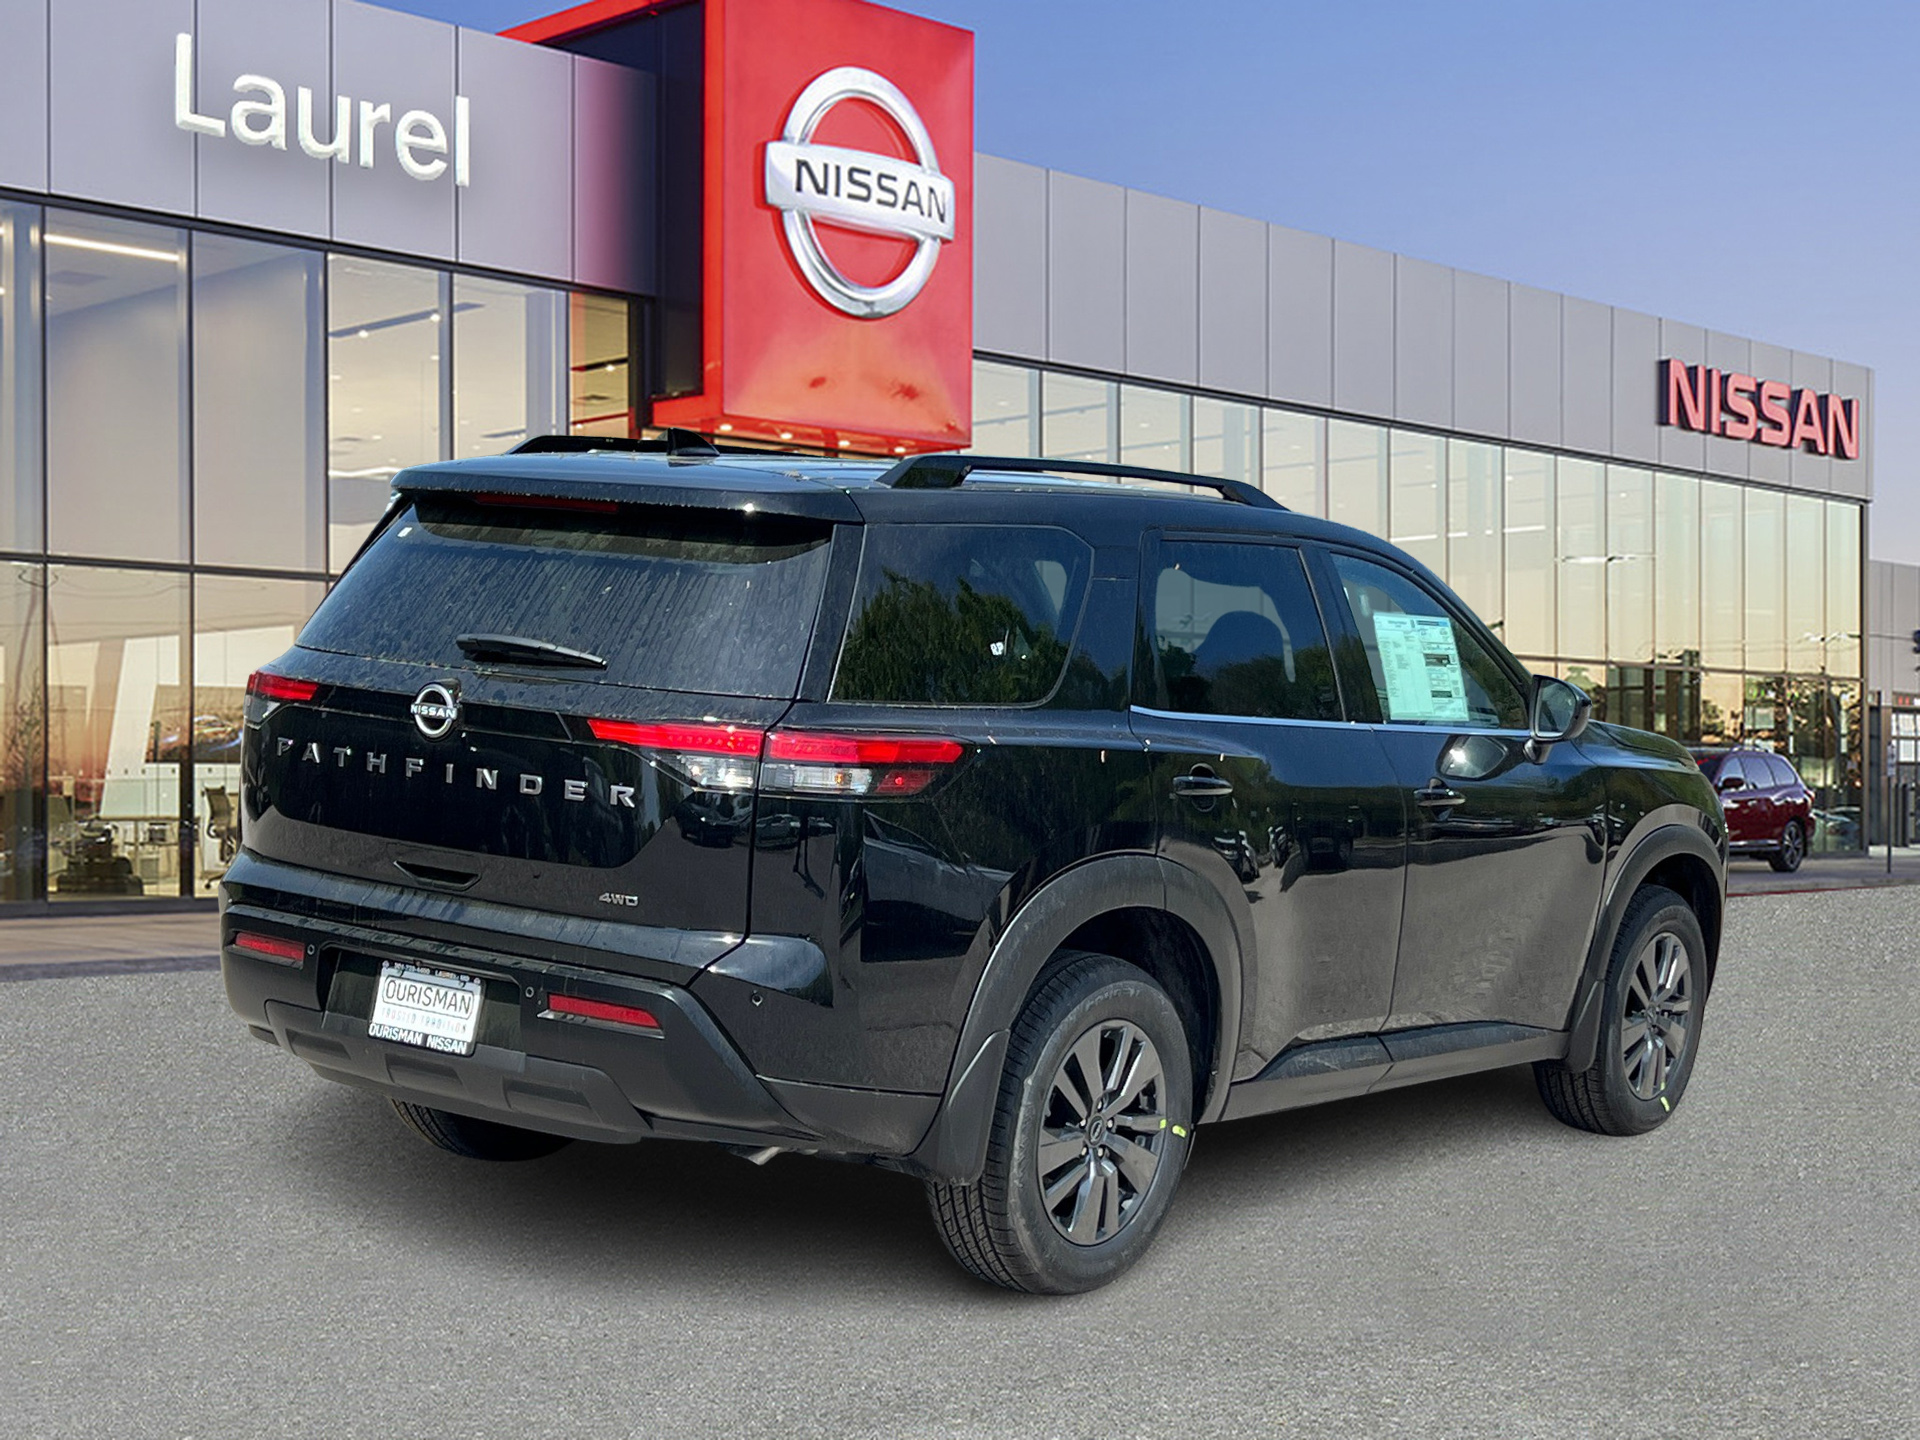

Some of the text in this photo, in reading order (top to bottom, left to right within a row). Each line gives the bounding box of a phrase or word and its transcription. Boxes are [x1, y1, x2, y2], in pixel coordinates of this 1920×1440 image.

[175, 33, 469, 187] Laurel
[795, 158, 947, 223] NISSAN
[1658, 358, 1860, 460] NISSAN
[411, 704, 457, 720] NISSAN
[276, 736, 636, 808] PATHFINDER
[599, 892, 639, 907] 4WD
[385, 979, 472, 1016] OURISMAN
[368, 1023, 468, 1055] OURISMAN NISSAN
